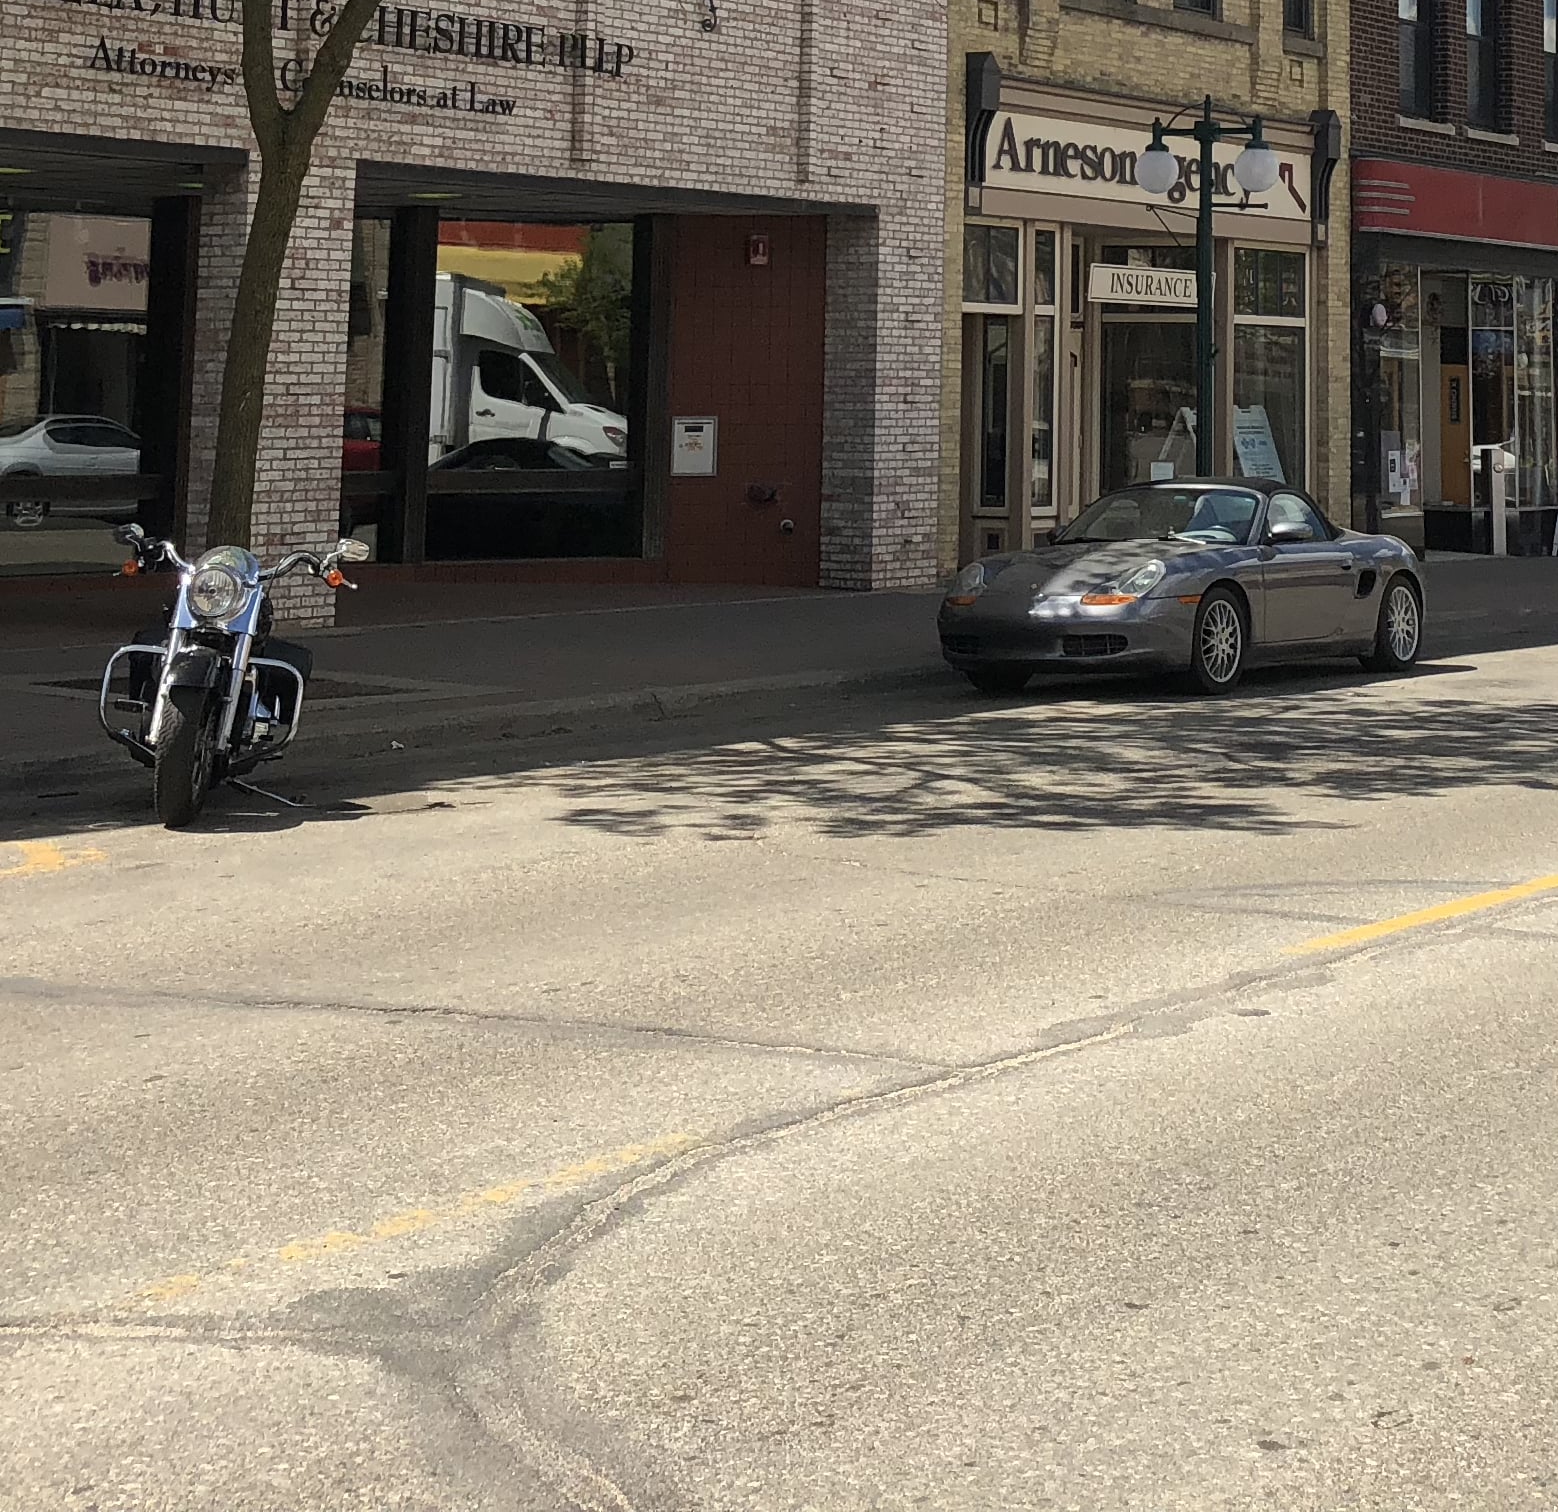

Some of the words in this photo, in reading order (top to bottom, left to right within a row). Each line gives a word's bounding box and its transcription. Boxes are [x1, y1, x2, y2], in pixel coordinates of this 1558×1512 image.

[90, 34, 236, 92] Attorneys
[280, 59, 427, 107] Cnselors
[436, 85, 460, 111] at
[469, 81, 517, 117] Law
[358, 4, 546, 68] HESHIRE
[556, 30, 634, 78] PLLP
[991, 115, 1140, 186] Arneson
[1165, 154, 1250, 211] genc
[1109, 271, 1193, 299] INSURANCE
